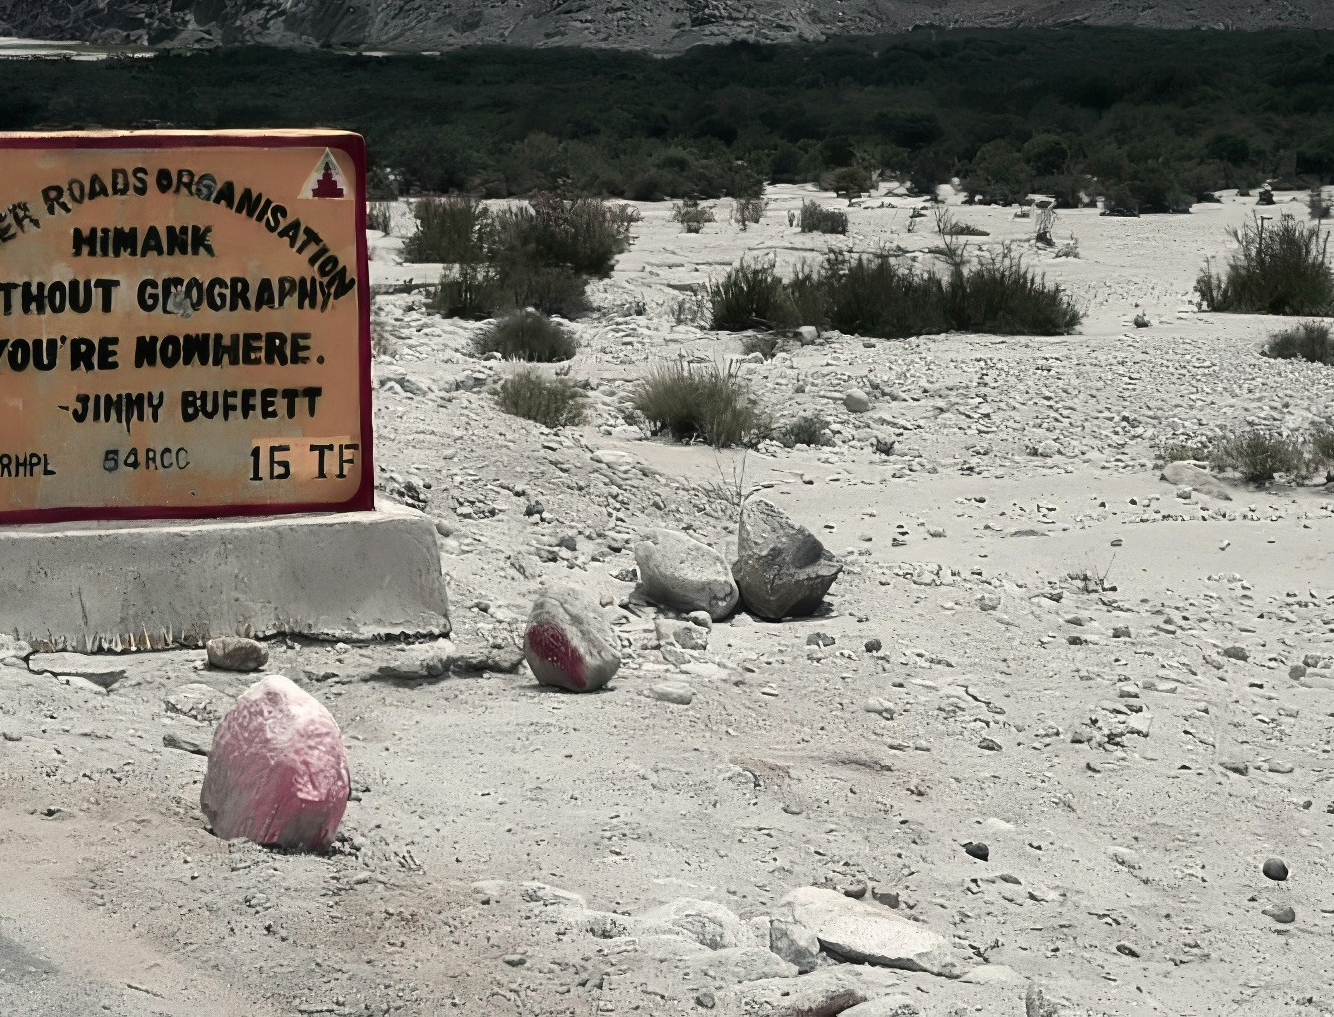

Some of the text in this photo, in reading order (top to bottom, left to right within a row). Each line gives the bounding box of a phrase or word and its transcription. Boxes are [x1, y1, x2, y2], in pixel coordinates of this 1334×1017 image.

[41, 167, 149, 215] ROADS
[156, 167, 356, 300] ORGANISATION
[72, 225, 215, 258] HIMANK
[137, 276, 332, 315] GEOGRAPHY
[134, 331, 325, 369] NOWHERE.
[180, 386, 323, 422] BUFFETT
[309, 444, 359, 479] TF
